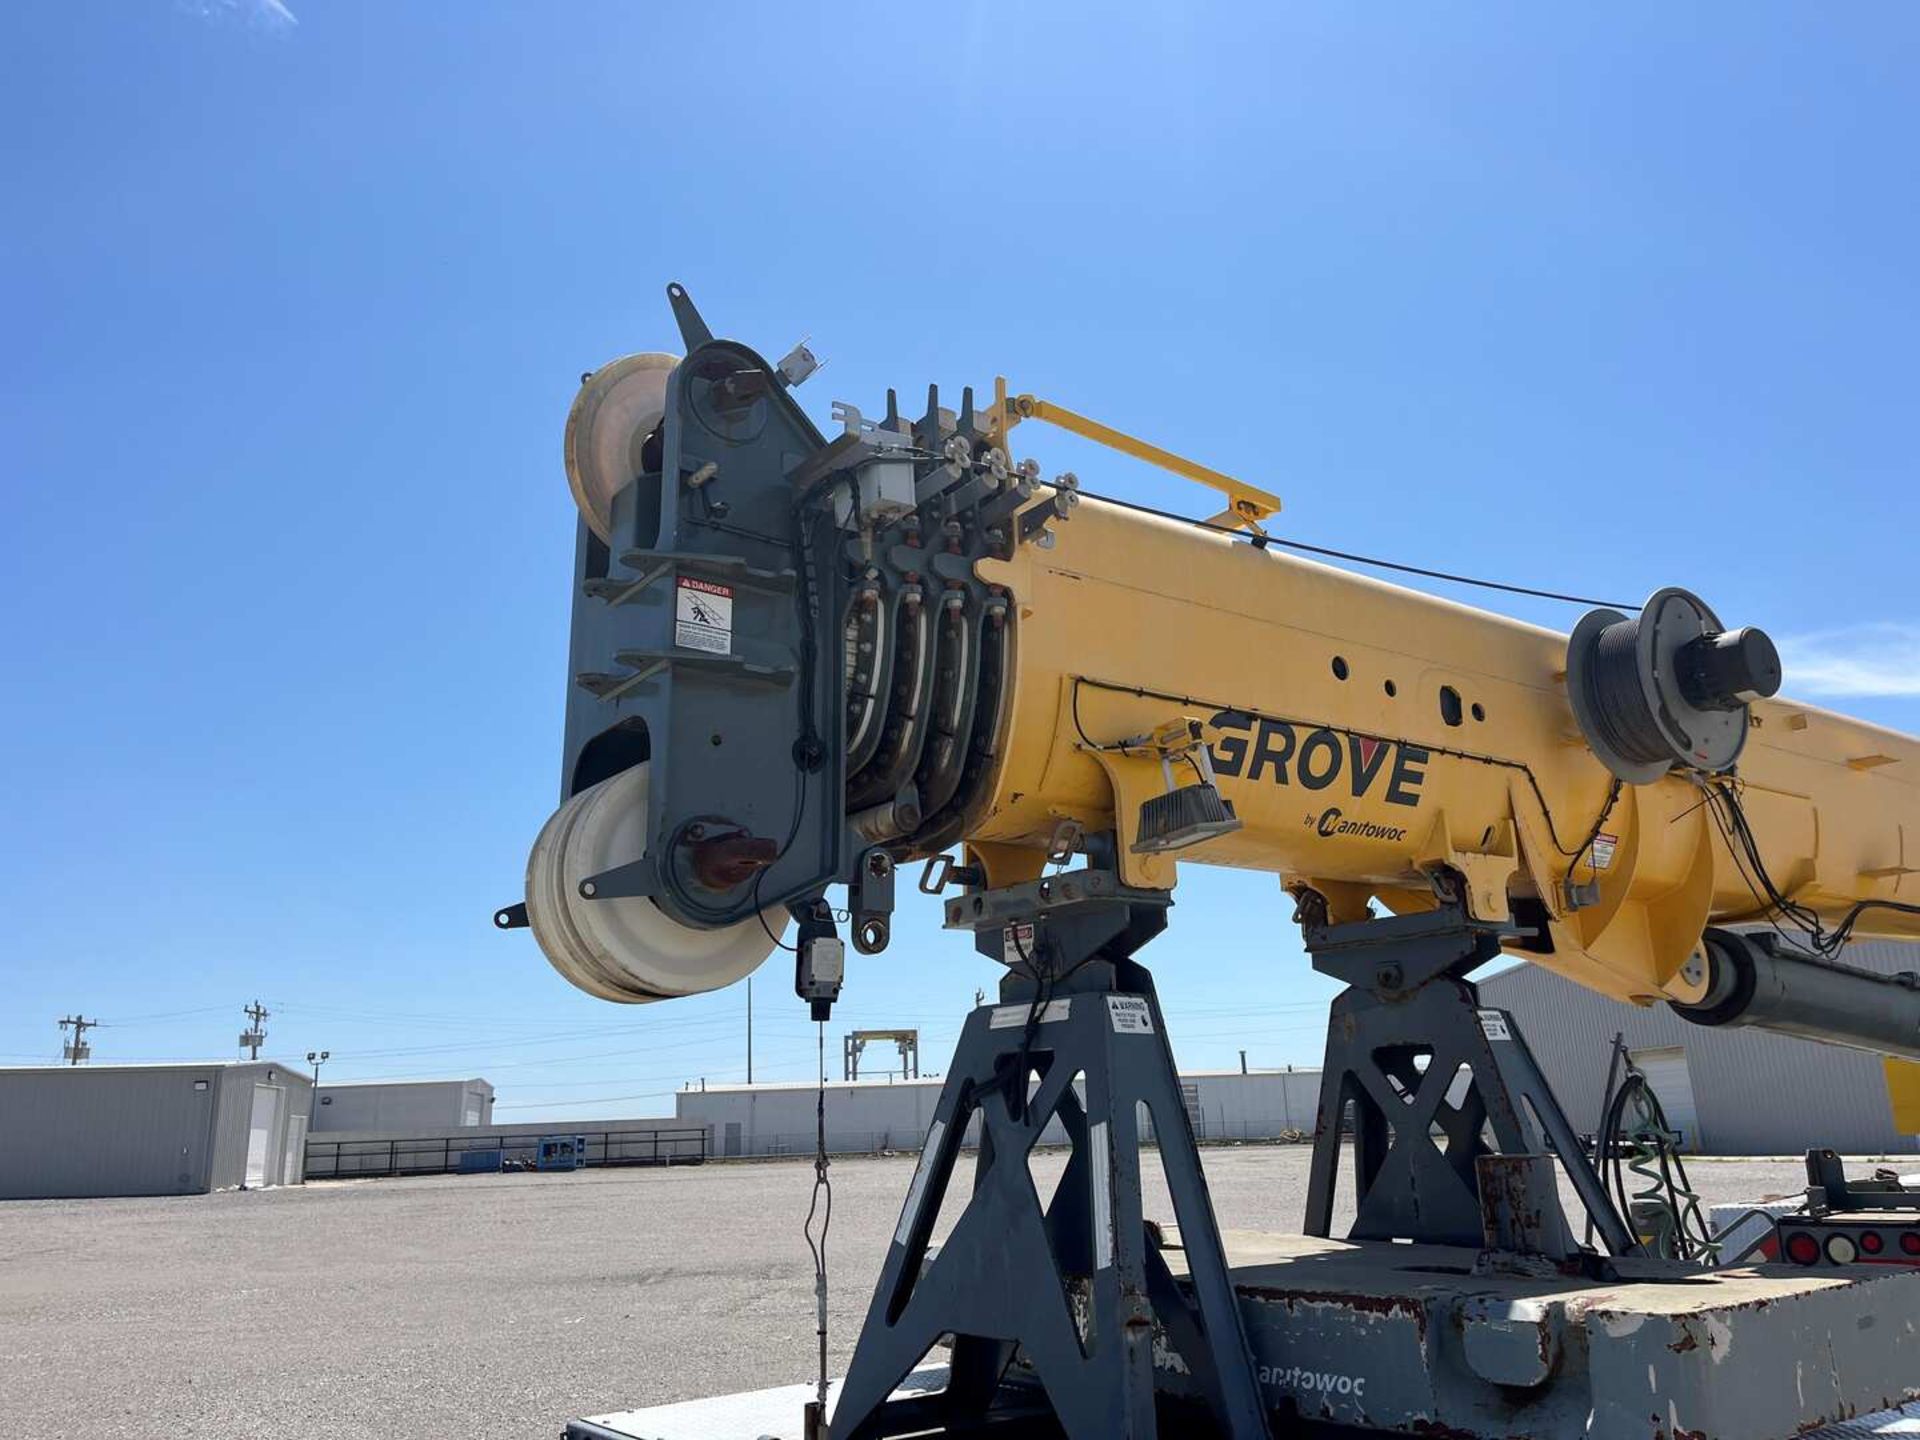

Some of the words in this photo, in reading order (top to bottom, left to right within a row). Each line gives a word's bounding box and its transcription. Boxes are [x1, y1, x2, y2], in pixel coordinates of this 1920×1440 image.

[692, 580, 729, 596] DANGER
[1207, 711, 1429, 807] GROVE
[1304, 813, 1317, 827] by
[1317, 807, 1408, 842] Manitowoc
[1259, 1366, 1365, 1396] anitowoc
